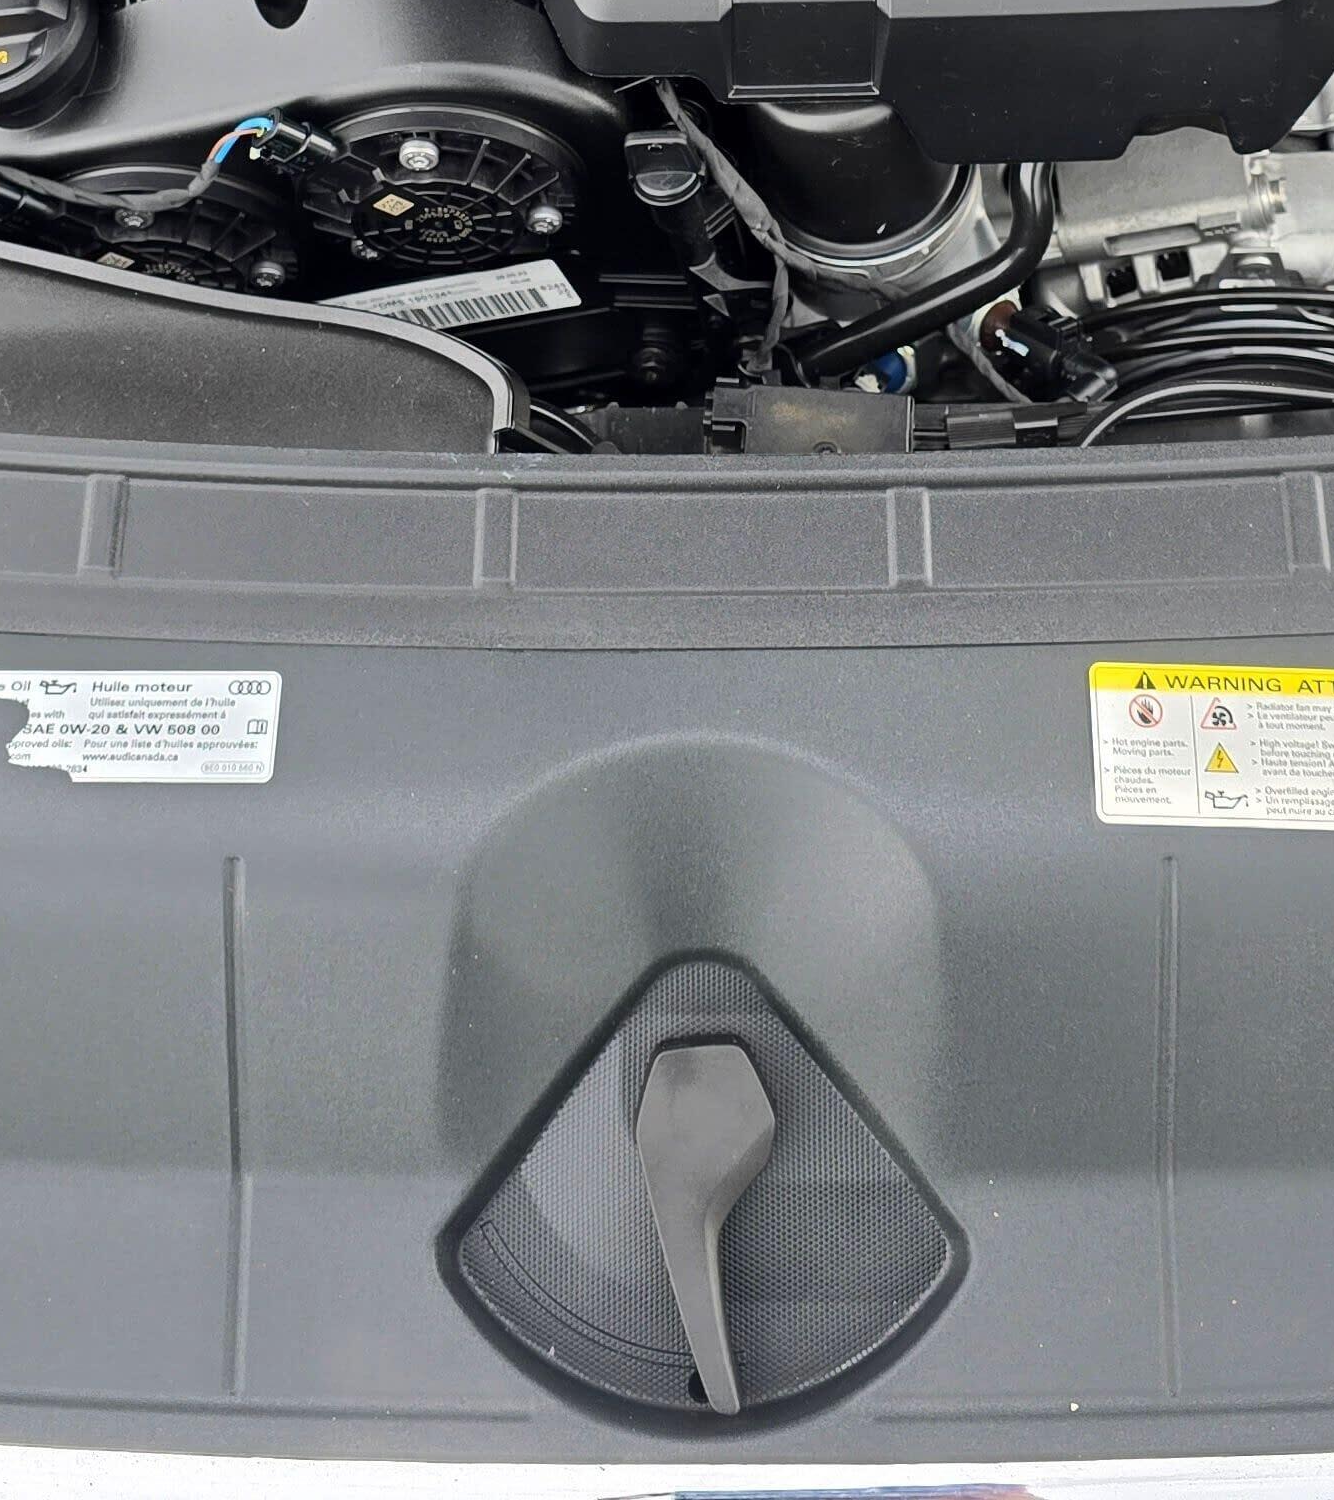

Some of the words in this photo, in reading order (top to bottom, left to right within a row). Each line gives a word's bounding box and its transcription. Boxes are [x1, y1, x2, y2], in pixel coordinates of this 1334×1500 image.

[11, 680, 31, 691] Oil
[92, 681, 130, 692] Huile
[134, 682, 194, 693] moteur
[1164, 674, 1282, 692] WARNING
[90, 697, 126, 707] Utilisez
[128, 697, 189, 709] uniquement
[190, 698, 203, 707] de
[44, 710, 65, 719] with
[1256, 703, 1294, 712] Radiator
[1296, 704, 1311, 712] fan
[1313, 706, 1332, 715] may
[88, 711, 104, 721] qui
[106, 710, 145, 719] satisfait
[147, 710, 214, 721] expressément
[1269, 713, 1317, 722] ventilateur
[22, 723, 55, 734] SAE
[60, 723, 110, 735] 0W-20
[116, 724, 127, 735] &
[134, 723, 164, 735] VW
[167, 723, 196, 735] 508
[201, 723, 221, 735] 00
[8, 738, 49, 750] pproved
[84, 739, 108, 748] Pour
[110, 740, 128, 748] une
[131, 739, 151, 748] liste
[154, 738, 194, 749] d'huiles
[196, 739, 259, 751] approuvées:
[1112, 738, 1128, 746] Hot
[1130, 739, 1161, 749] engine
[1163, 740, 1188, 750] parts.
[1259, 739, 1281, 749] High
[82, 752, 178, 761] www.audicanada.ca
[1113, 747, 1147, 757] Moving
[1149, 749, 1175, 758] parts.
[1260, 749, 1289, 758] before
[1291, 750, 1331, 760] touching
[1261, 758, 1288, 767] Haute
[1113, 766, 1142, 775] Pièces
[1144, 767, 1157, 775] du
[1158, 768, 1191, 776] moteur
[1262, 768, 1288, 776] avant
[1289, 768, 1300, 777] de
[1146, 786, 1157, 794] en
[1264, 787, 1309, 796] Overfilled
[1266, 796, 1279, 804] Un
